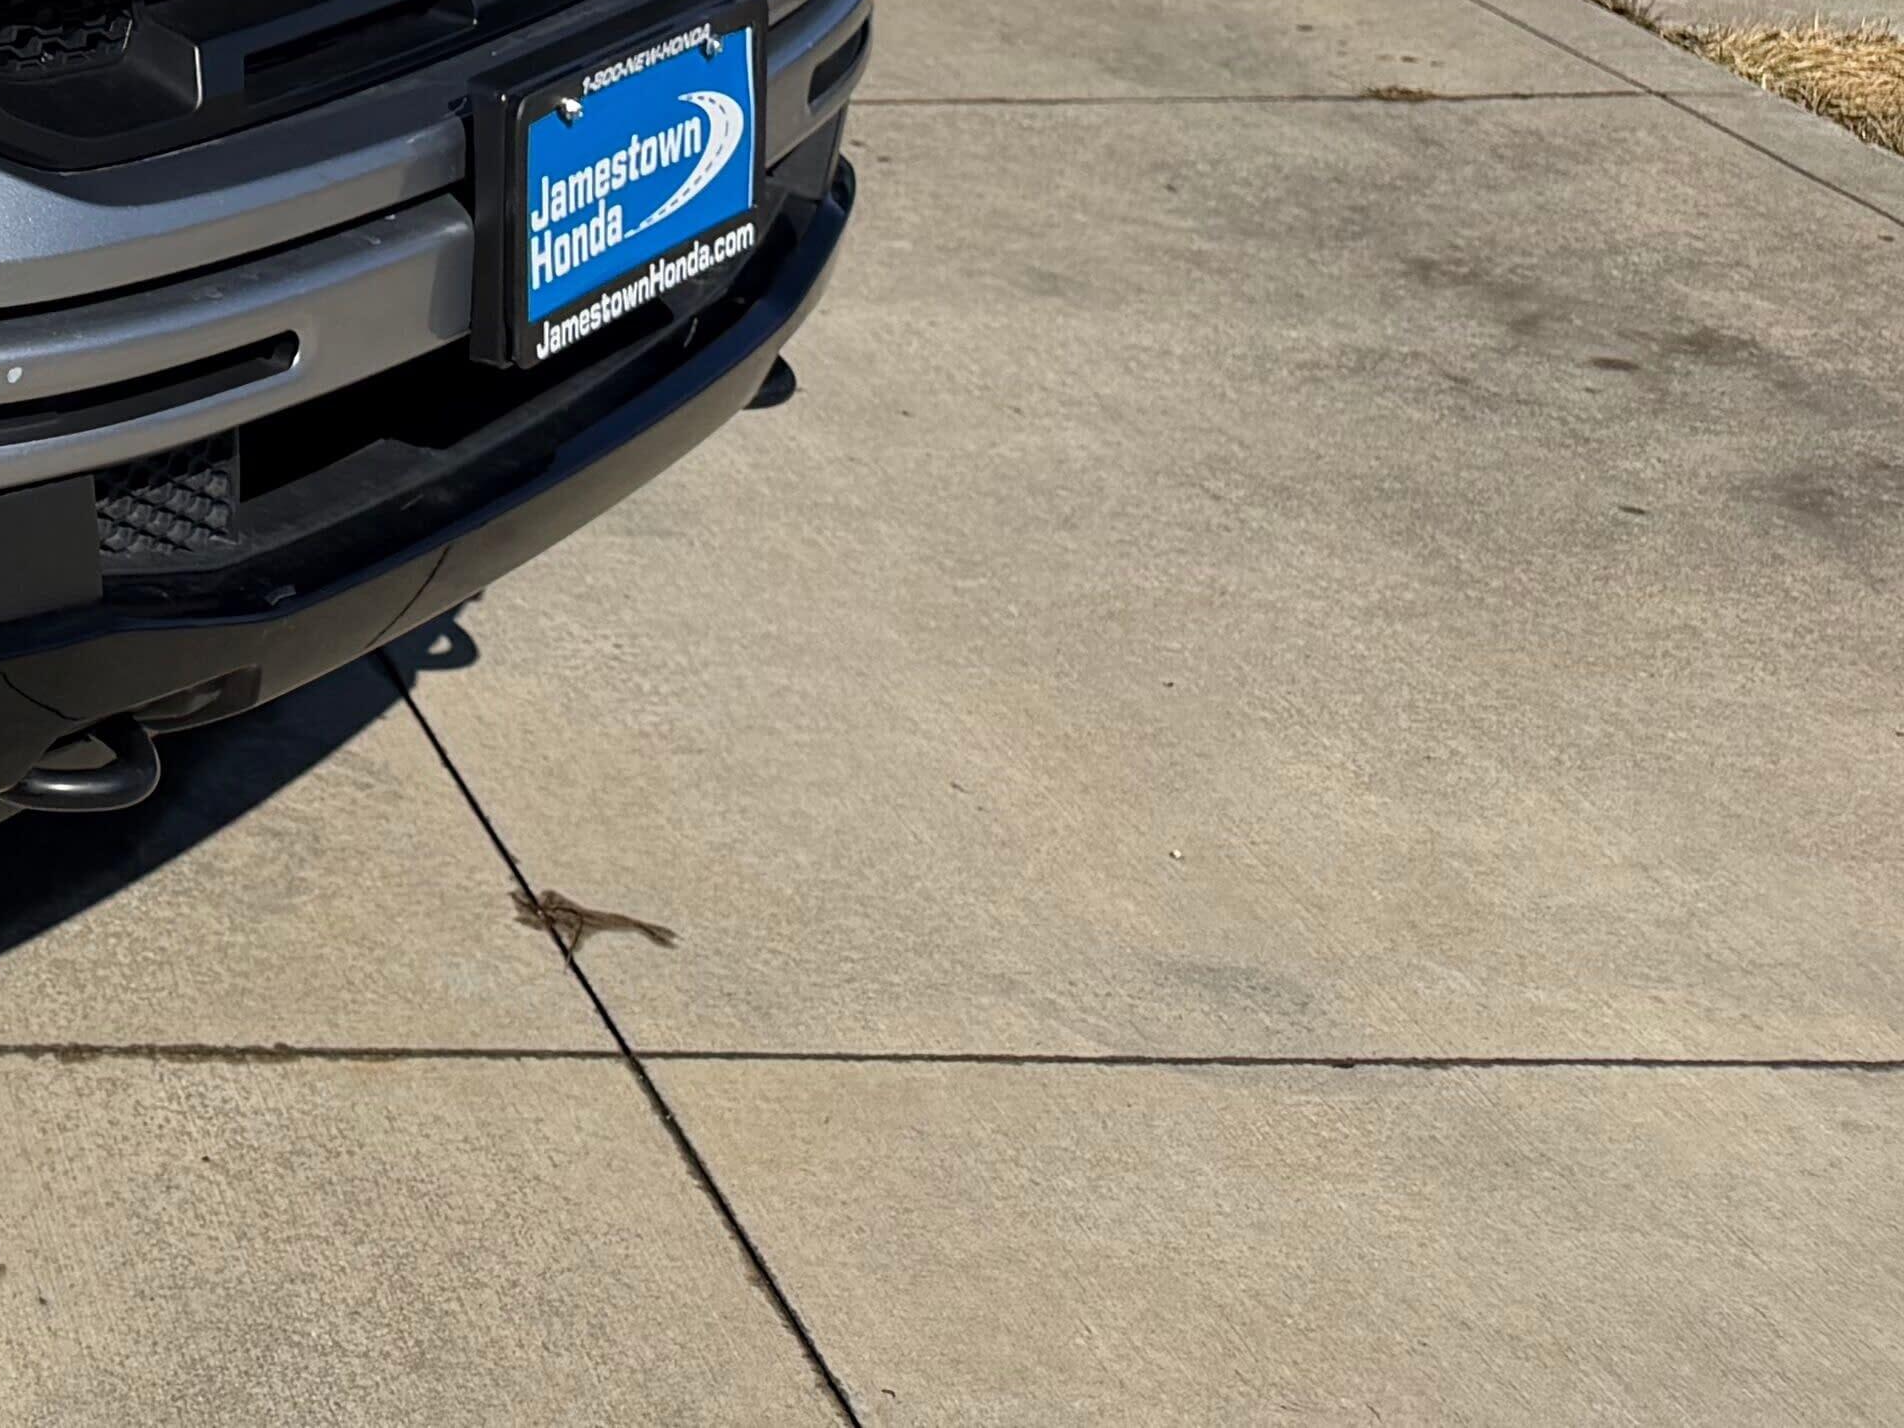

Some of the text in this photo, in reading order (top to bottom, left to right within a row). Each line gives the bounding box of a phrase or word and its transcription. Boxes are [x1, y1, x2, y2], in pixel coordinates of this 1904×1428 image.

[530, 116, 702, 232] Jamestown
[530, 199, 623, 290] Honda
[536, 222, 755, 360] JamestownHonda.com
